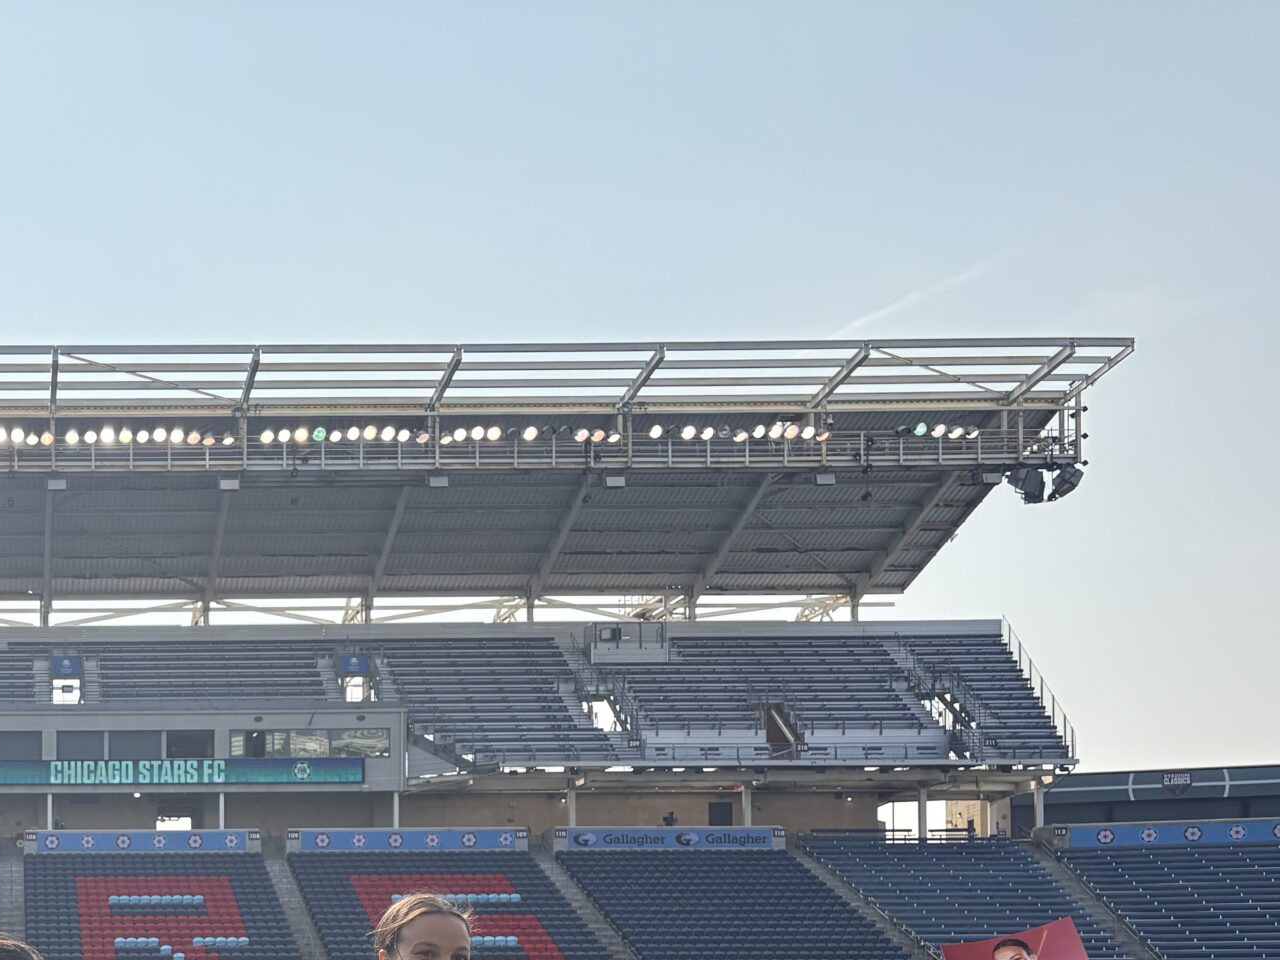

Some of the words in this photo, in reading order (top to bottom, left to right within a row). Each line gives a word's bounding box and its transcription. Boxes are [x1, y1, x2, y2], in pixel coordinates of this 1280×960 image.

[50, 761, 133, 783] CHICAGO
[138, 760, 198, 783] STARS
[203, 760, 226, 783] FC
[603, 830, 665, 846] Gallagher
[705, 830, 767, 846] Gallagher
